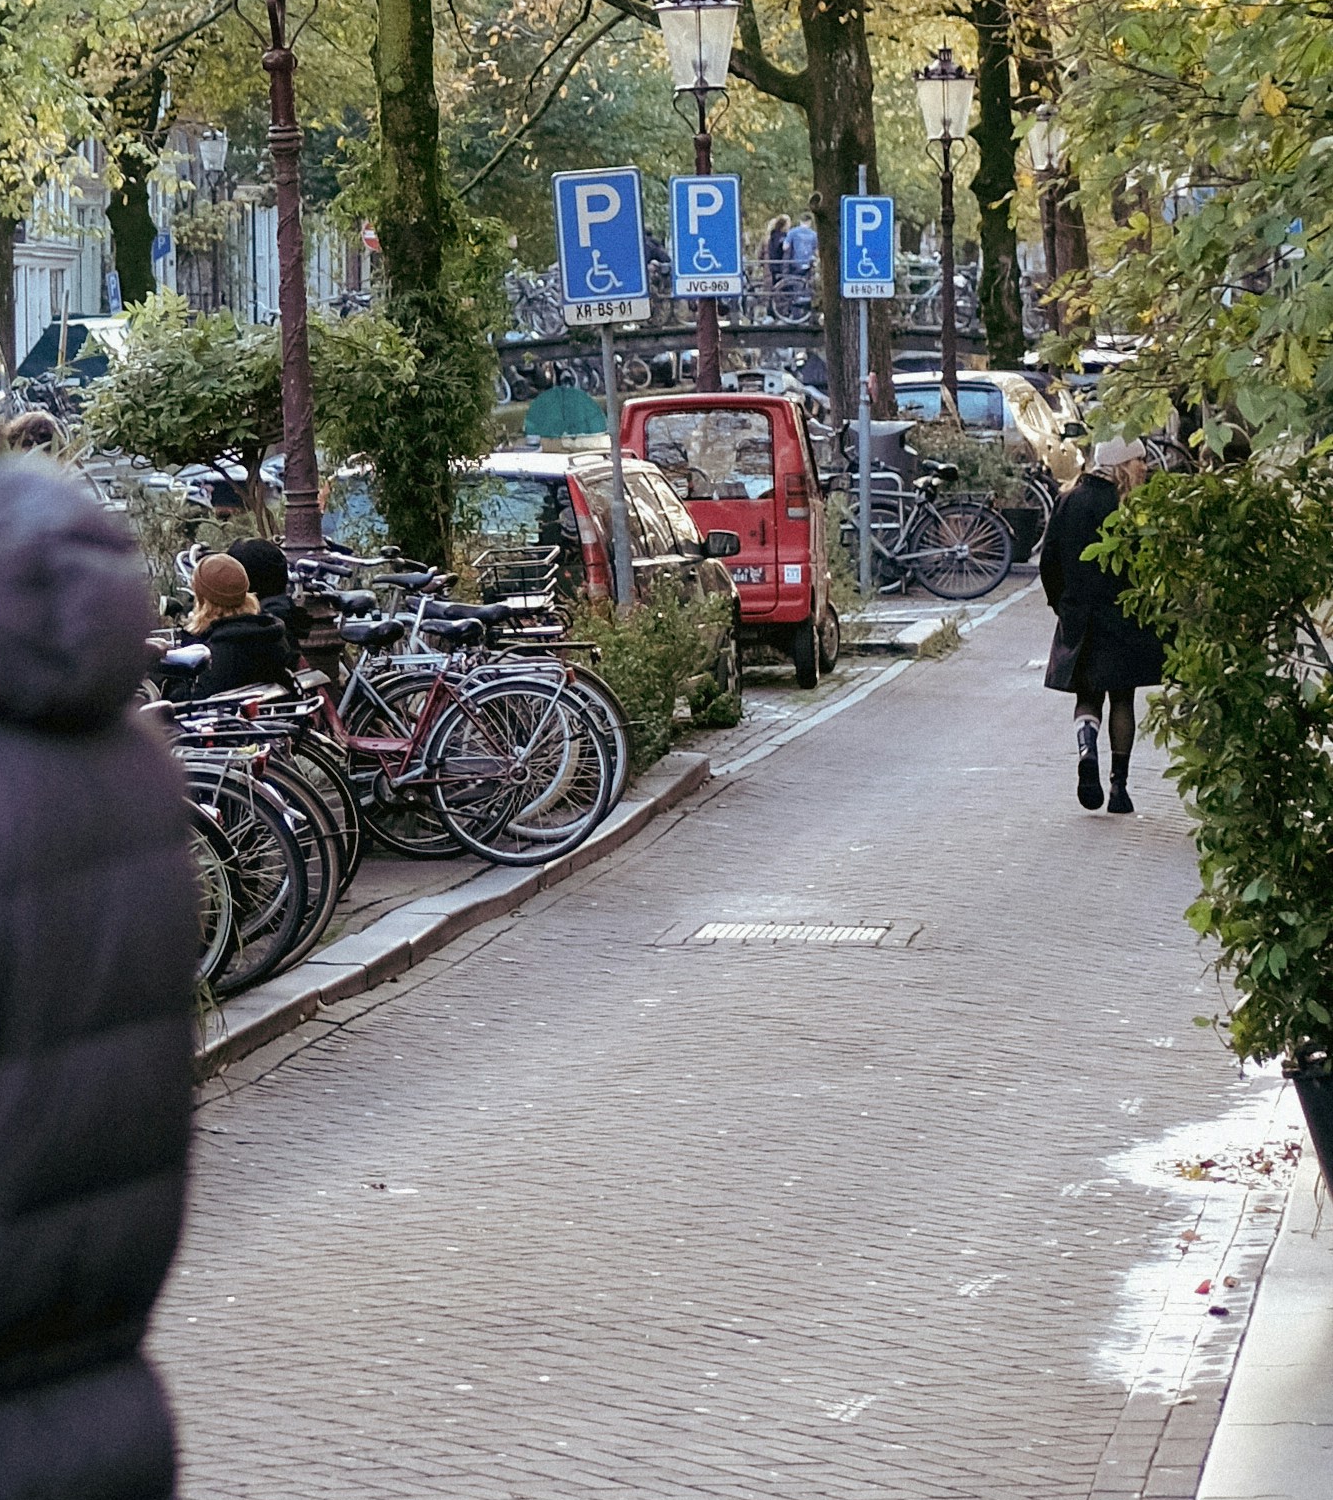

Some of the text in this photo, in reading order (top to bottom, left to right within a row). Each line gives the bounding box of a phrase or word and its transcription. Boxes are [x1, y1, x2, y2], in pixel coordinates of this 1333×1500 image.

[575, 183, 621, 247] P
[688, 184, 724, 235] P
[855, 204, 882, 247] P
[686, 280, 730, 292] JVG-969
[576, 300, 633, 319] XR-BS-01
